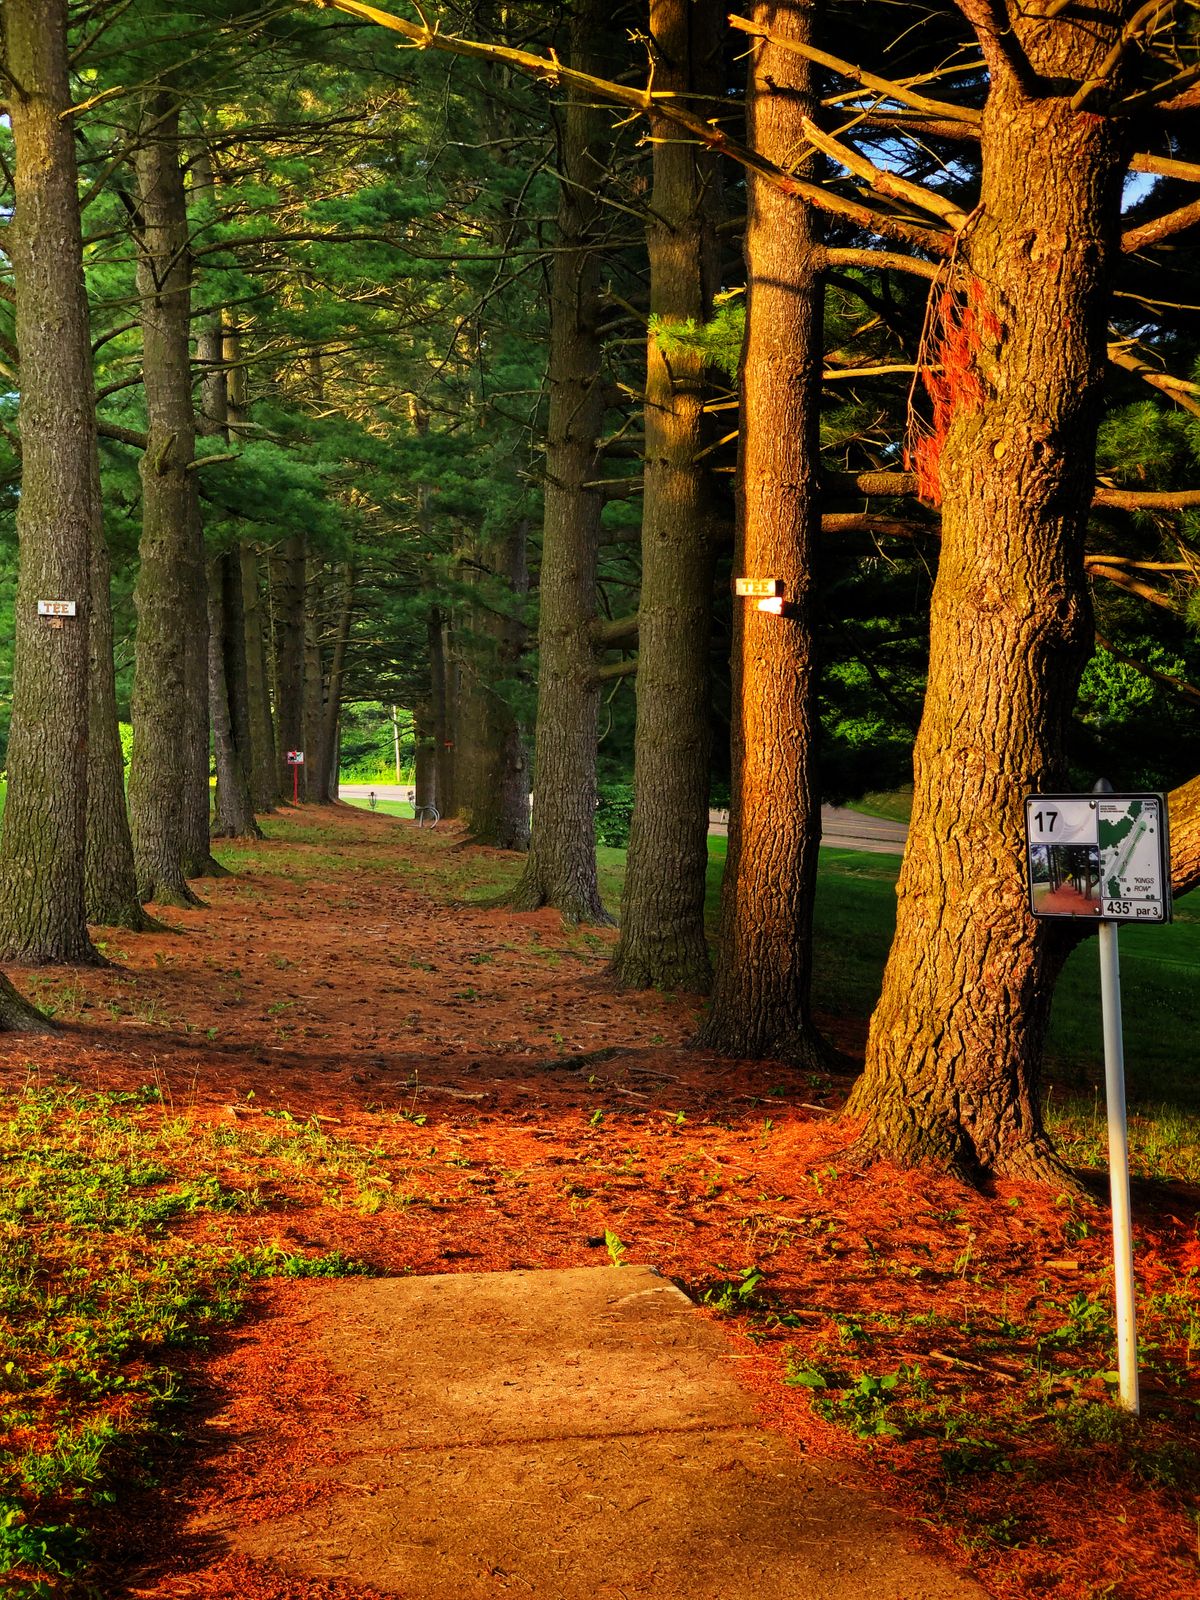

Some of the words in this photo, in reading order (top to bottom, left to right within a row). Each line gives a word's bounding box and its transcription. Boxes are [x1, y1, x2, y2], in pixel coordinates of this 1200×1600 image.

[742, 581, 769, 592] TEE
[44, 603, 69, 613] TEE
[1034, 811, 1058, 832] 17
[1107, 901, 1132, 914] 435'
[1136, 908, 1150, 917] par
[1152, 907, 1158, 915] 3
